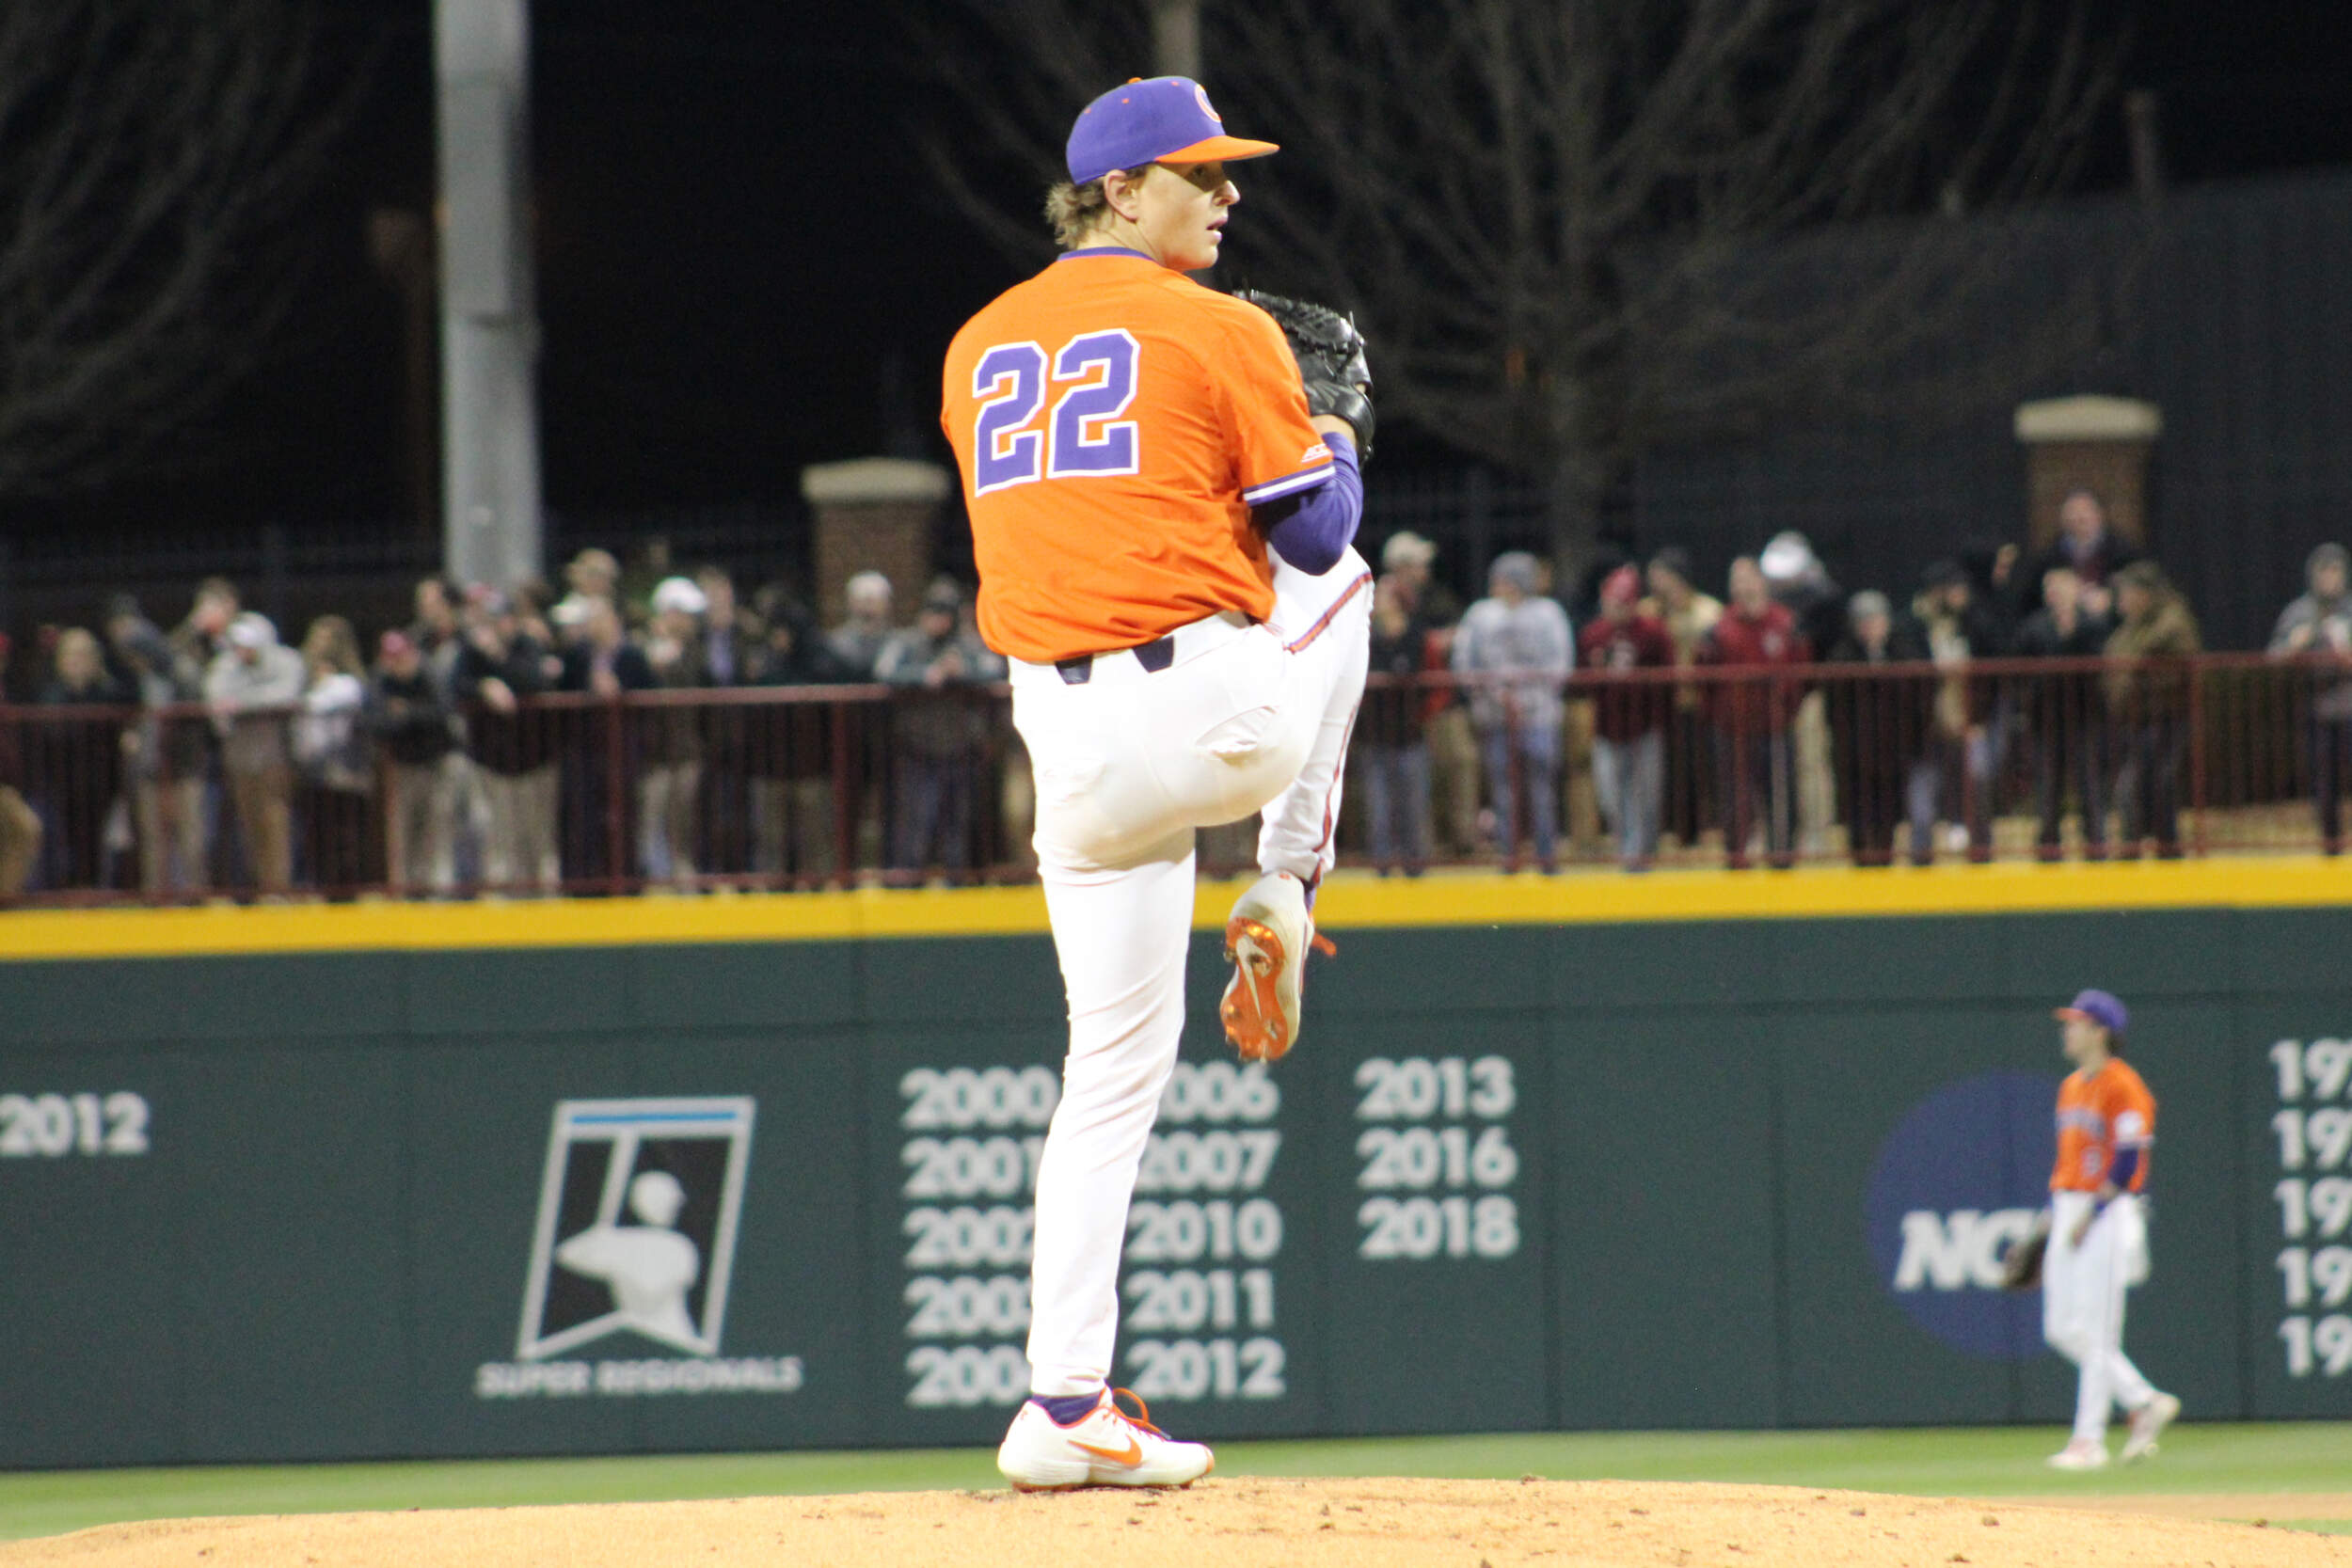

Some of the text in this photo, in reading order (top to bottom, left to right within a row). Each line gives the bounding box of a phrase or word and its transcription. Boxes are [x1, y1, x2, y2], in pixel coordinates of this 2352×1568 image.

[972, 328, 1141, 498] 22
[899, 1066, 1059, 1128] 2000
[1158, 1061, 1280, 1122] 006
[1354, 1055, 1516, 1119] 2013
[2269, 1037, 2352, 1101] 19
[0, 1091, 150, 1156] 2012
[2271, 1107, 2352, 1170] 19
[1133, 1131, 1281, 1193] 2007
[1356, 1128, 1518, 1189] 2016
[904, 1206, 1035, 1268] 200
[1126, 1200, 1283, 1260] 2010
[1358, 1196, 1519, 1259] 2018
[2274, 1176, 2352, 1239] 19
[1894, 1209, 2038, 1291] NC
[2276, 1245, 2352, 1308] 19
[905, 1275, 1033, 1337] 200
[1127, 1270, 1274, 1330] 2011
[906, 1344, 1032, 1405] 200
[1127, 1339, 1286, 1400] 2012
[2279, 1314, 2352, 1378] 19
[475, 1357, 803, 1398] SUPER REGIONALS
